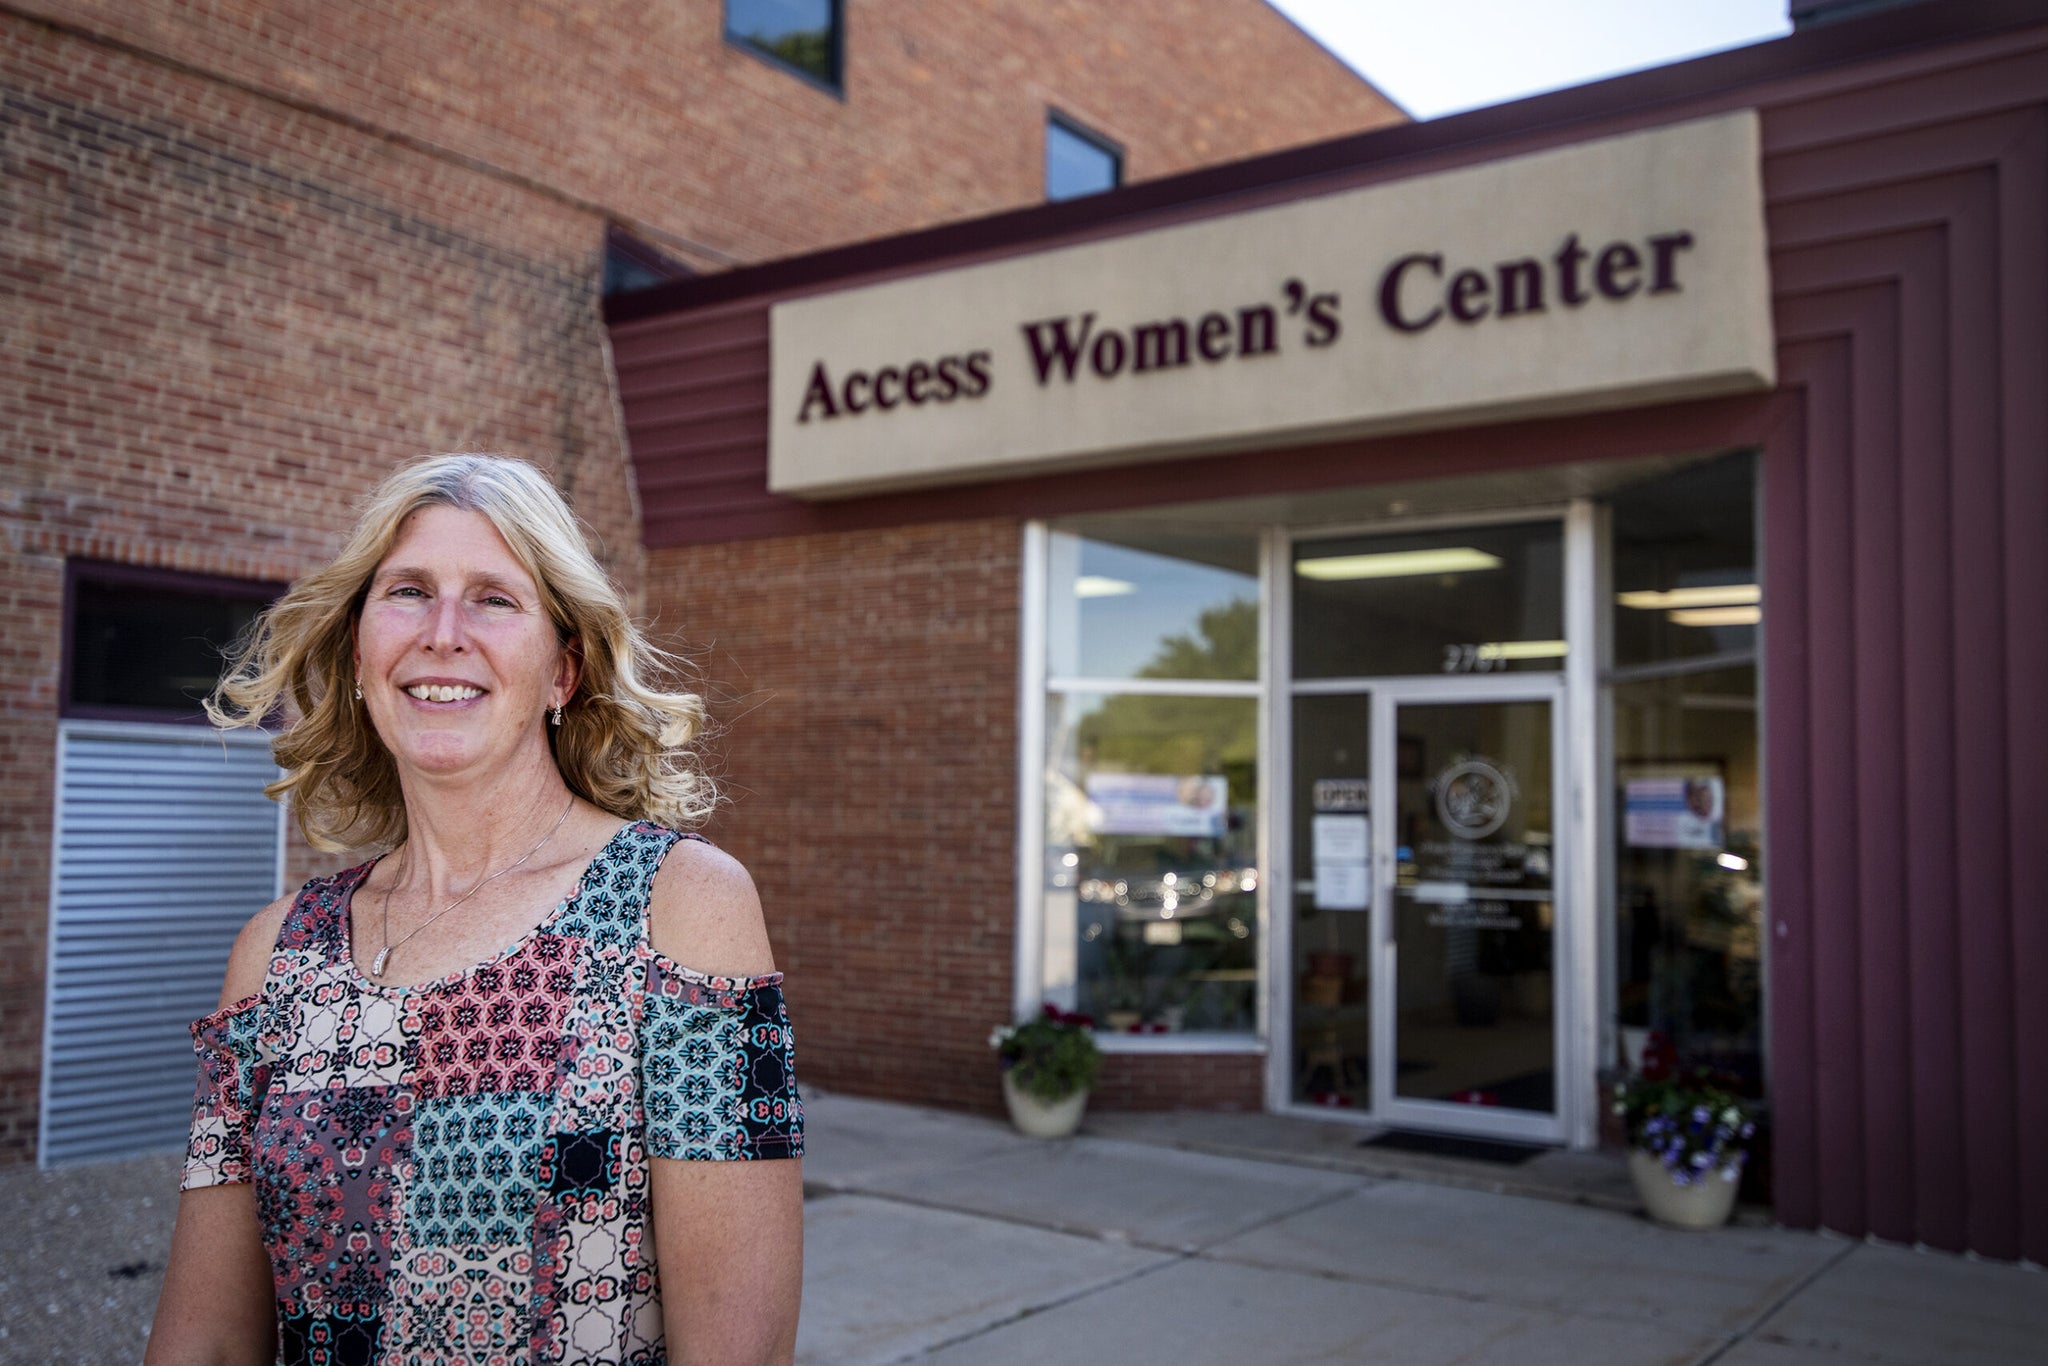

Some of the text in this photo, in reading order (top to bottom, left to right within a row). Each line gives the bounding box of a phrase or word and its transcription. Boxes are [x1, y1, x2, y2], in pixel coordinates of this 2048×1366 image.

[797, 229, 1698, 425] Access Women's Center
